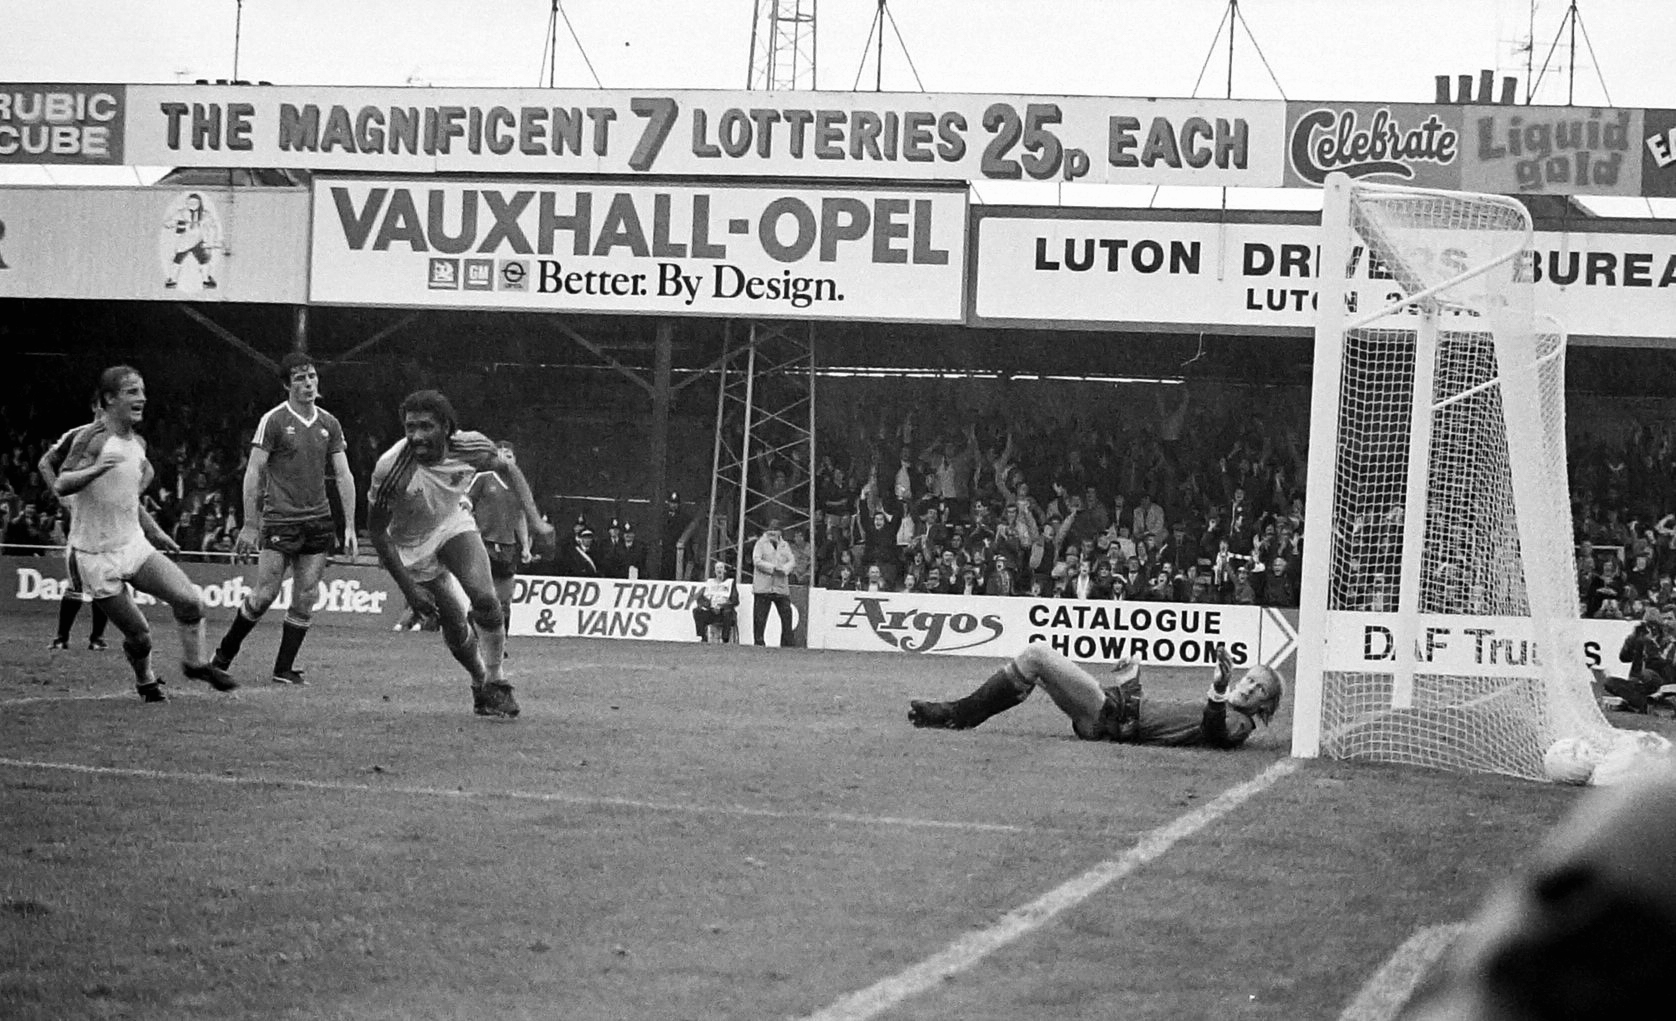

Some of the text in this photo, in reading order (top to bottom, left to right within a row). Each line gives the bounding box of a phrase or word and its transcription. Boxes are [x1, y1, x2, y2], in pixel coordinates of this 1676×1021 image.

[0, 125, 110, 158] CUBE
[161, 97, 1249, 180] THE MAGNIFICENT 7 LOTTERIES 25p EACH
[1289, 108, 1458, 186] Celebrate
[1477, 109, 1630, 160] Liquid
[1515, 151, 1623, 190] gold
[330, 187, 950, 266] VAUXHALL-OPEL
[1035, 237, 1201, 274] LUTON
[537, 260, 845, 307] Better. By Design.
[1246, 288, 1358, 313] LUTN
[535, 608, 651, 637] & VANS
[836, 597, 1004, 652] Argos
[1029, 604, 1221, 635] CATALOGUE
[1364, 625, 1450, 662] DF
